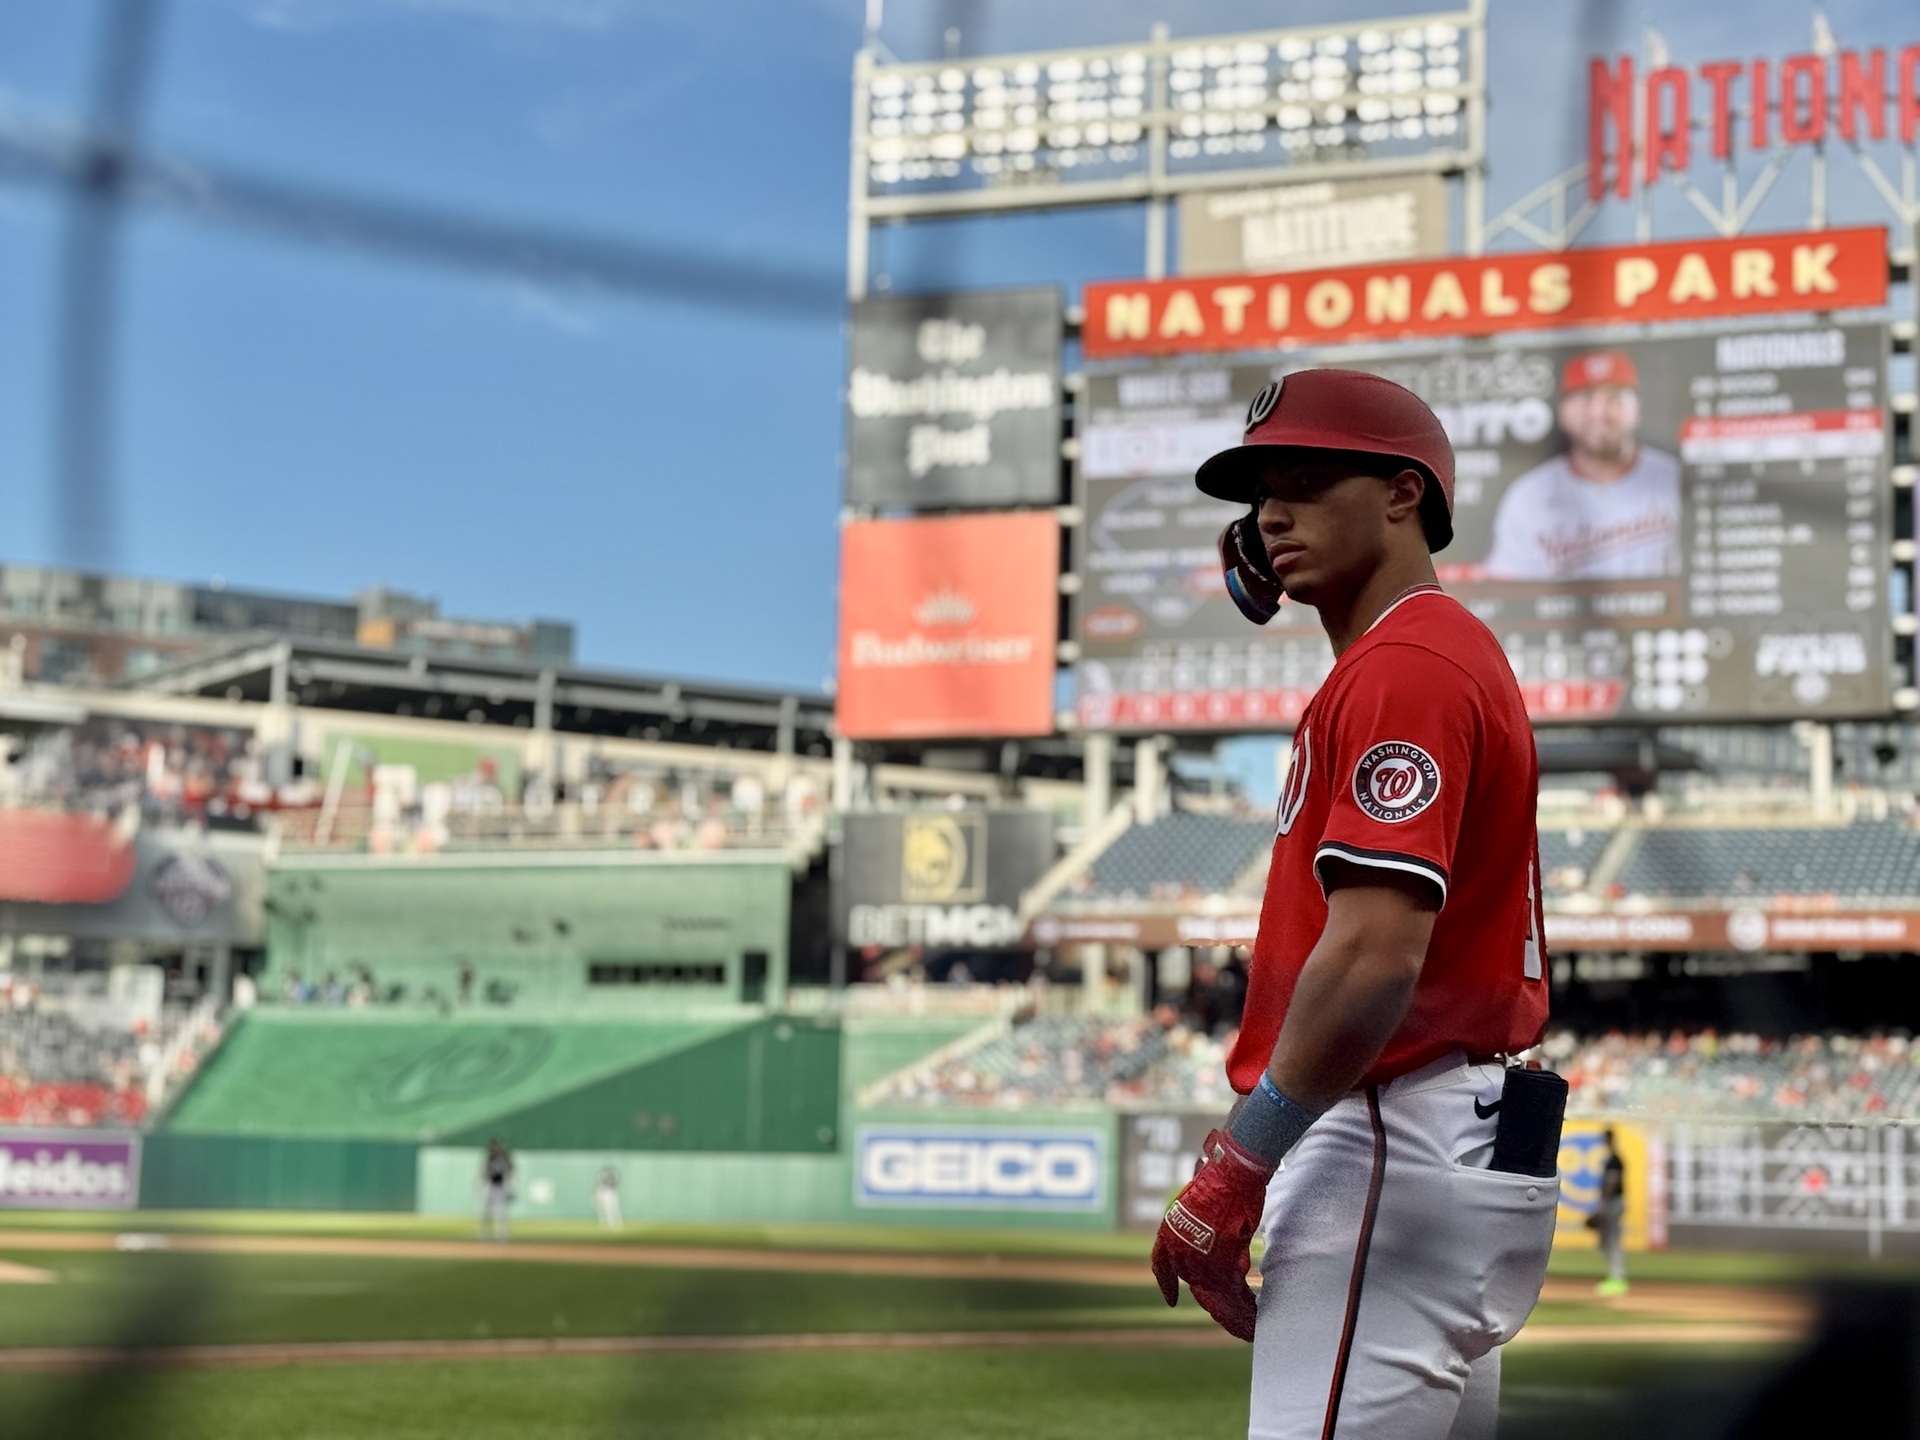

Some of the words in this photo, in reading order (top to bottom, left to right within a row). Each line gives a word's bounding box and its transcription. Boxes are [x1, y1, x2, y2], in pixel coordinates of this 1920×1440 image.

[1105, 262, 1573, 342] NATIONALS
[1614, 242, 1840, 308] PARK
[850, 366, 1052, 421] Washington
[851, 630, 1032, 669] Budweiser
[1361, 745, 1436, 780] WASHINGTON
[1358, 791, 1427, 820] NATIONALS
[866, 1141, 1096, 1195] GEICO
